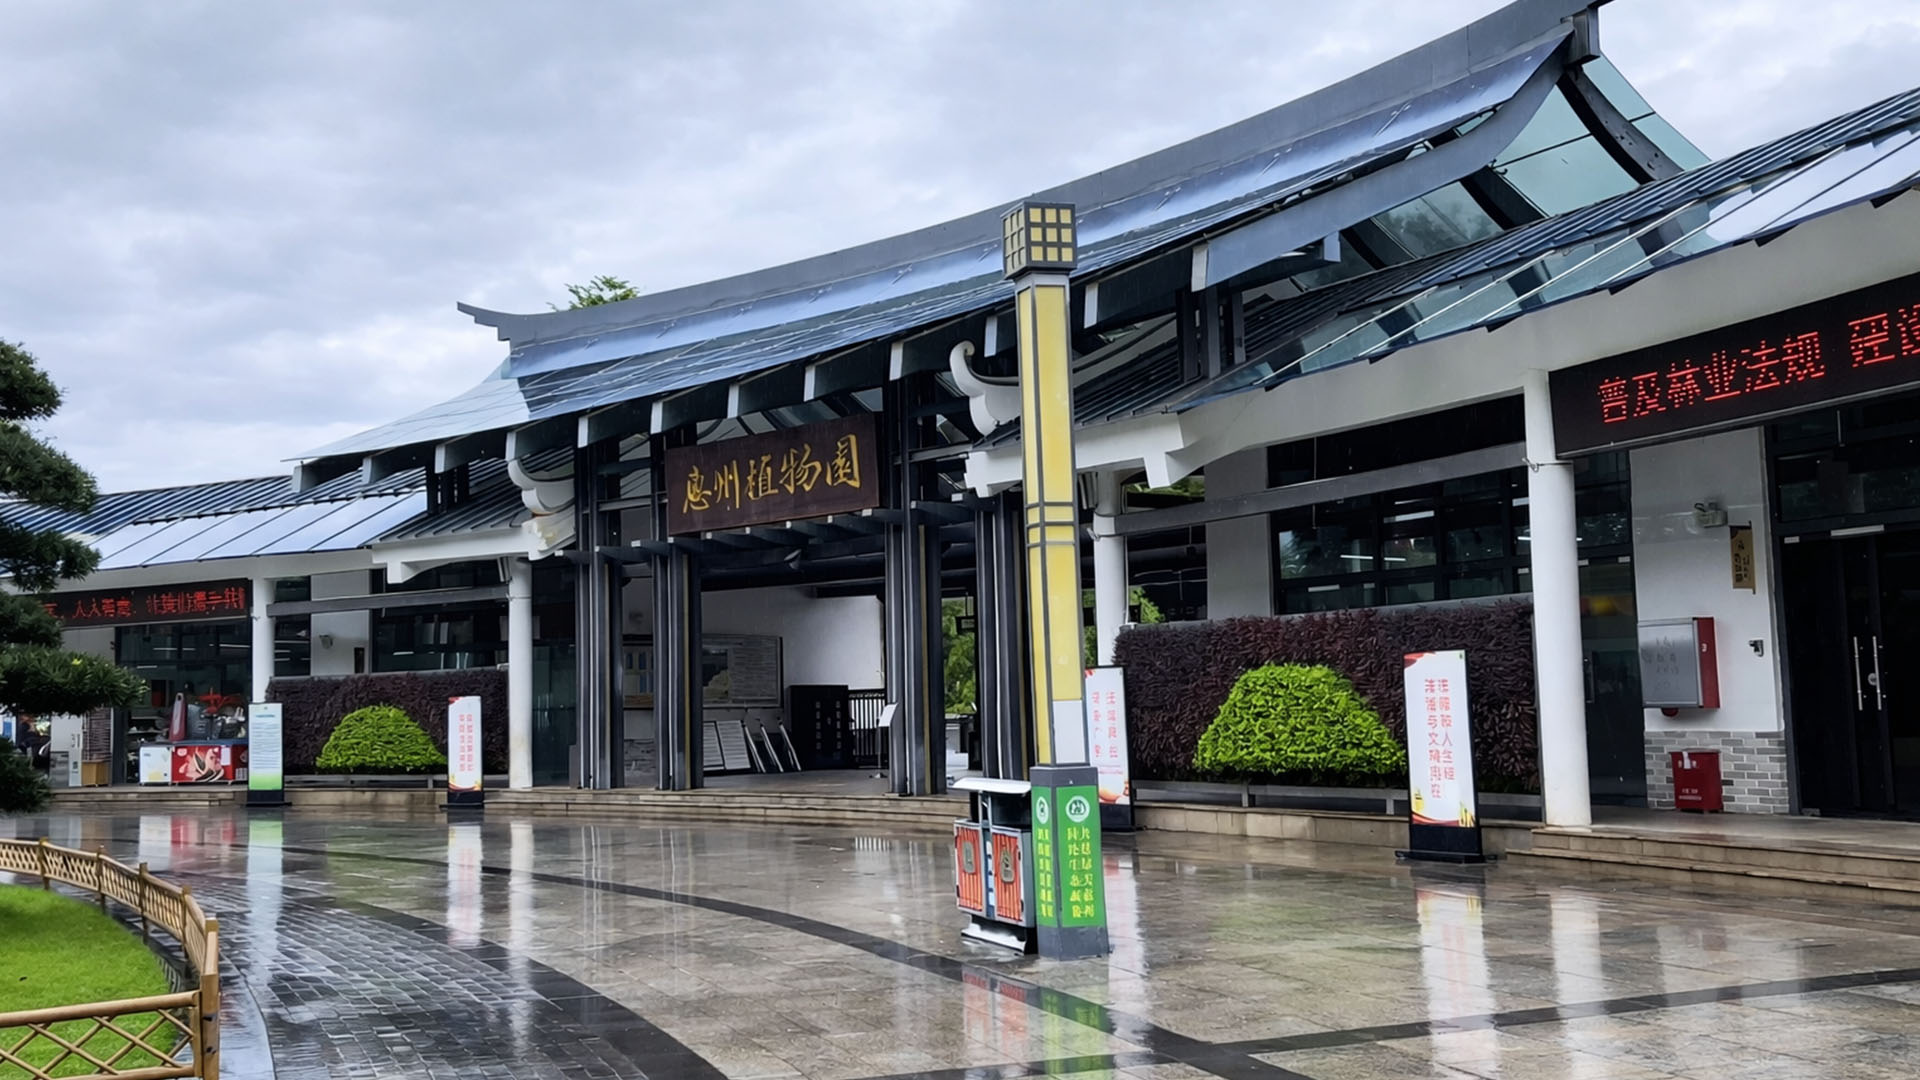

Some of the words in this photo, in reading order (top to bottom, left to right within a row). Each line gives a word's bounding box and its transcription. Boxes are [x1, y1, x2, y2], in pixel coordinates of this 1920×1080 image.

[1598, 330, 1825, 423] 普及林业法规
